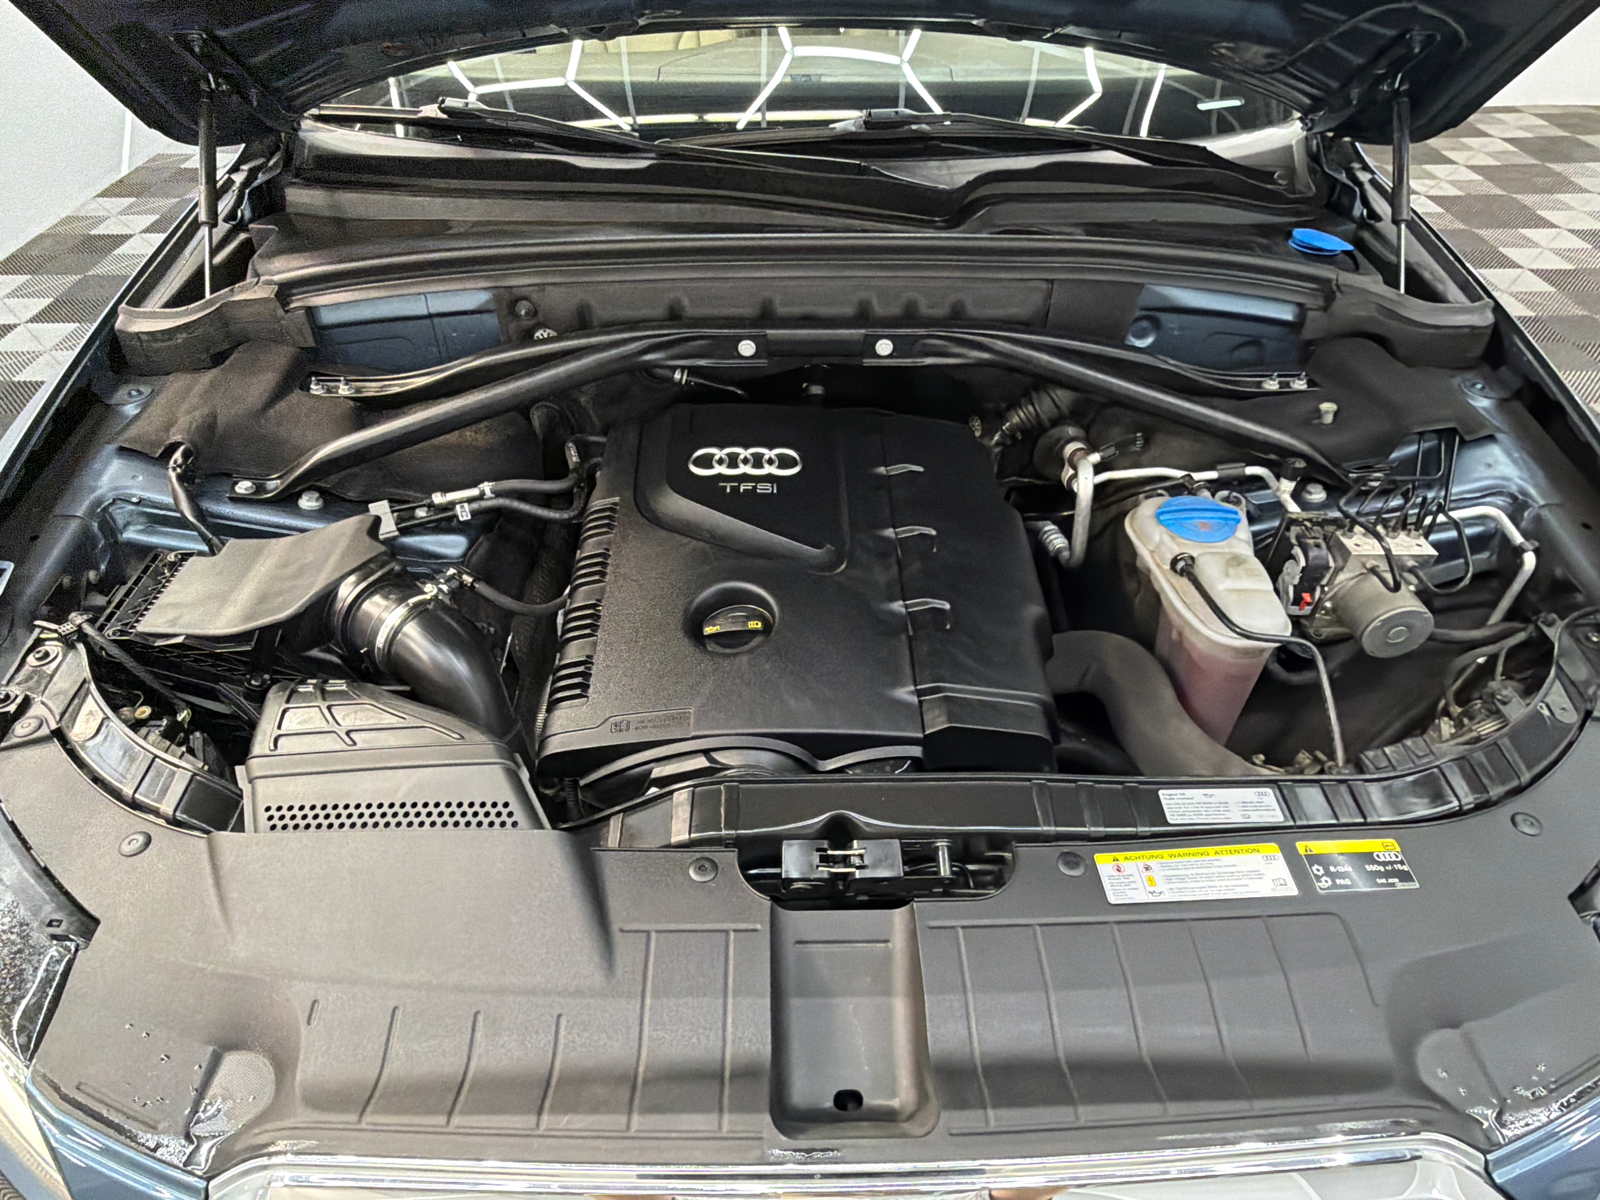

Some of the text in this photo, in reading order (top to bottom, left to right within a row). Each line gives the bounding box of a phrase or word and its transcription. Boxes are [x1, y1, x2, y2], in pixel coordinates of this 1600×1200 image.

[719, 483, 777, 493] TFSI
[1168, 851, 1209, 859] WARNING
[1214, 848, 1260, 856] ATTENTION
